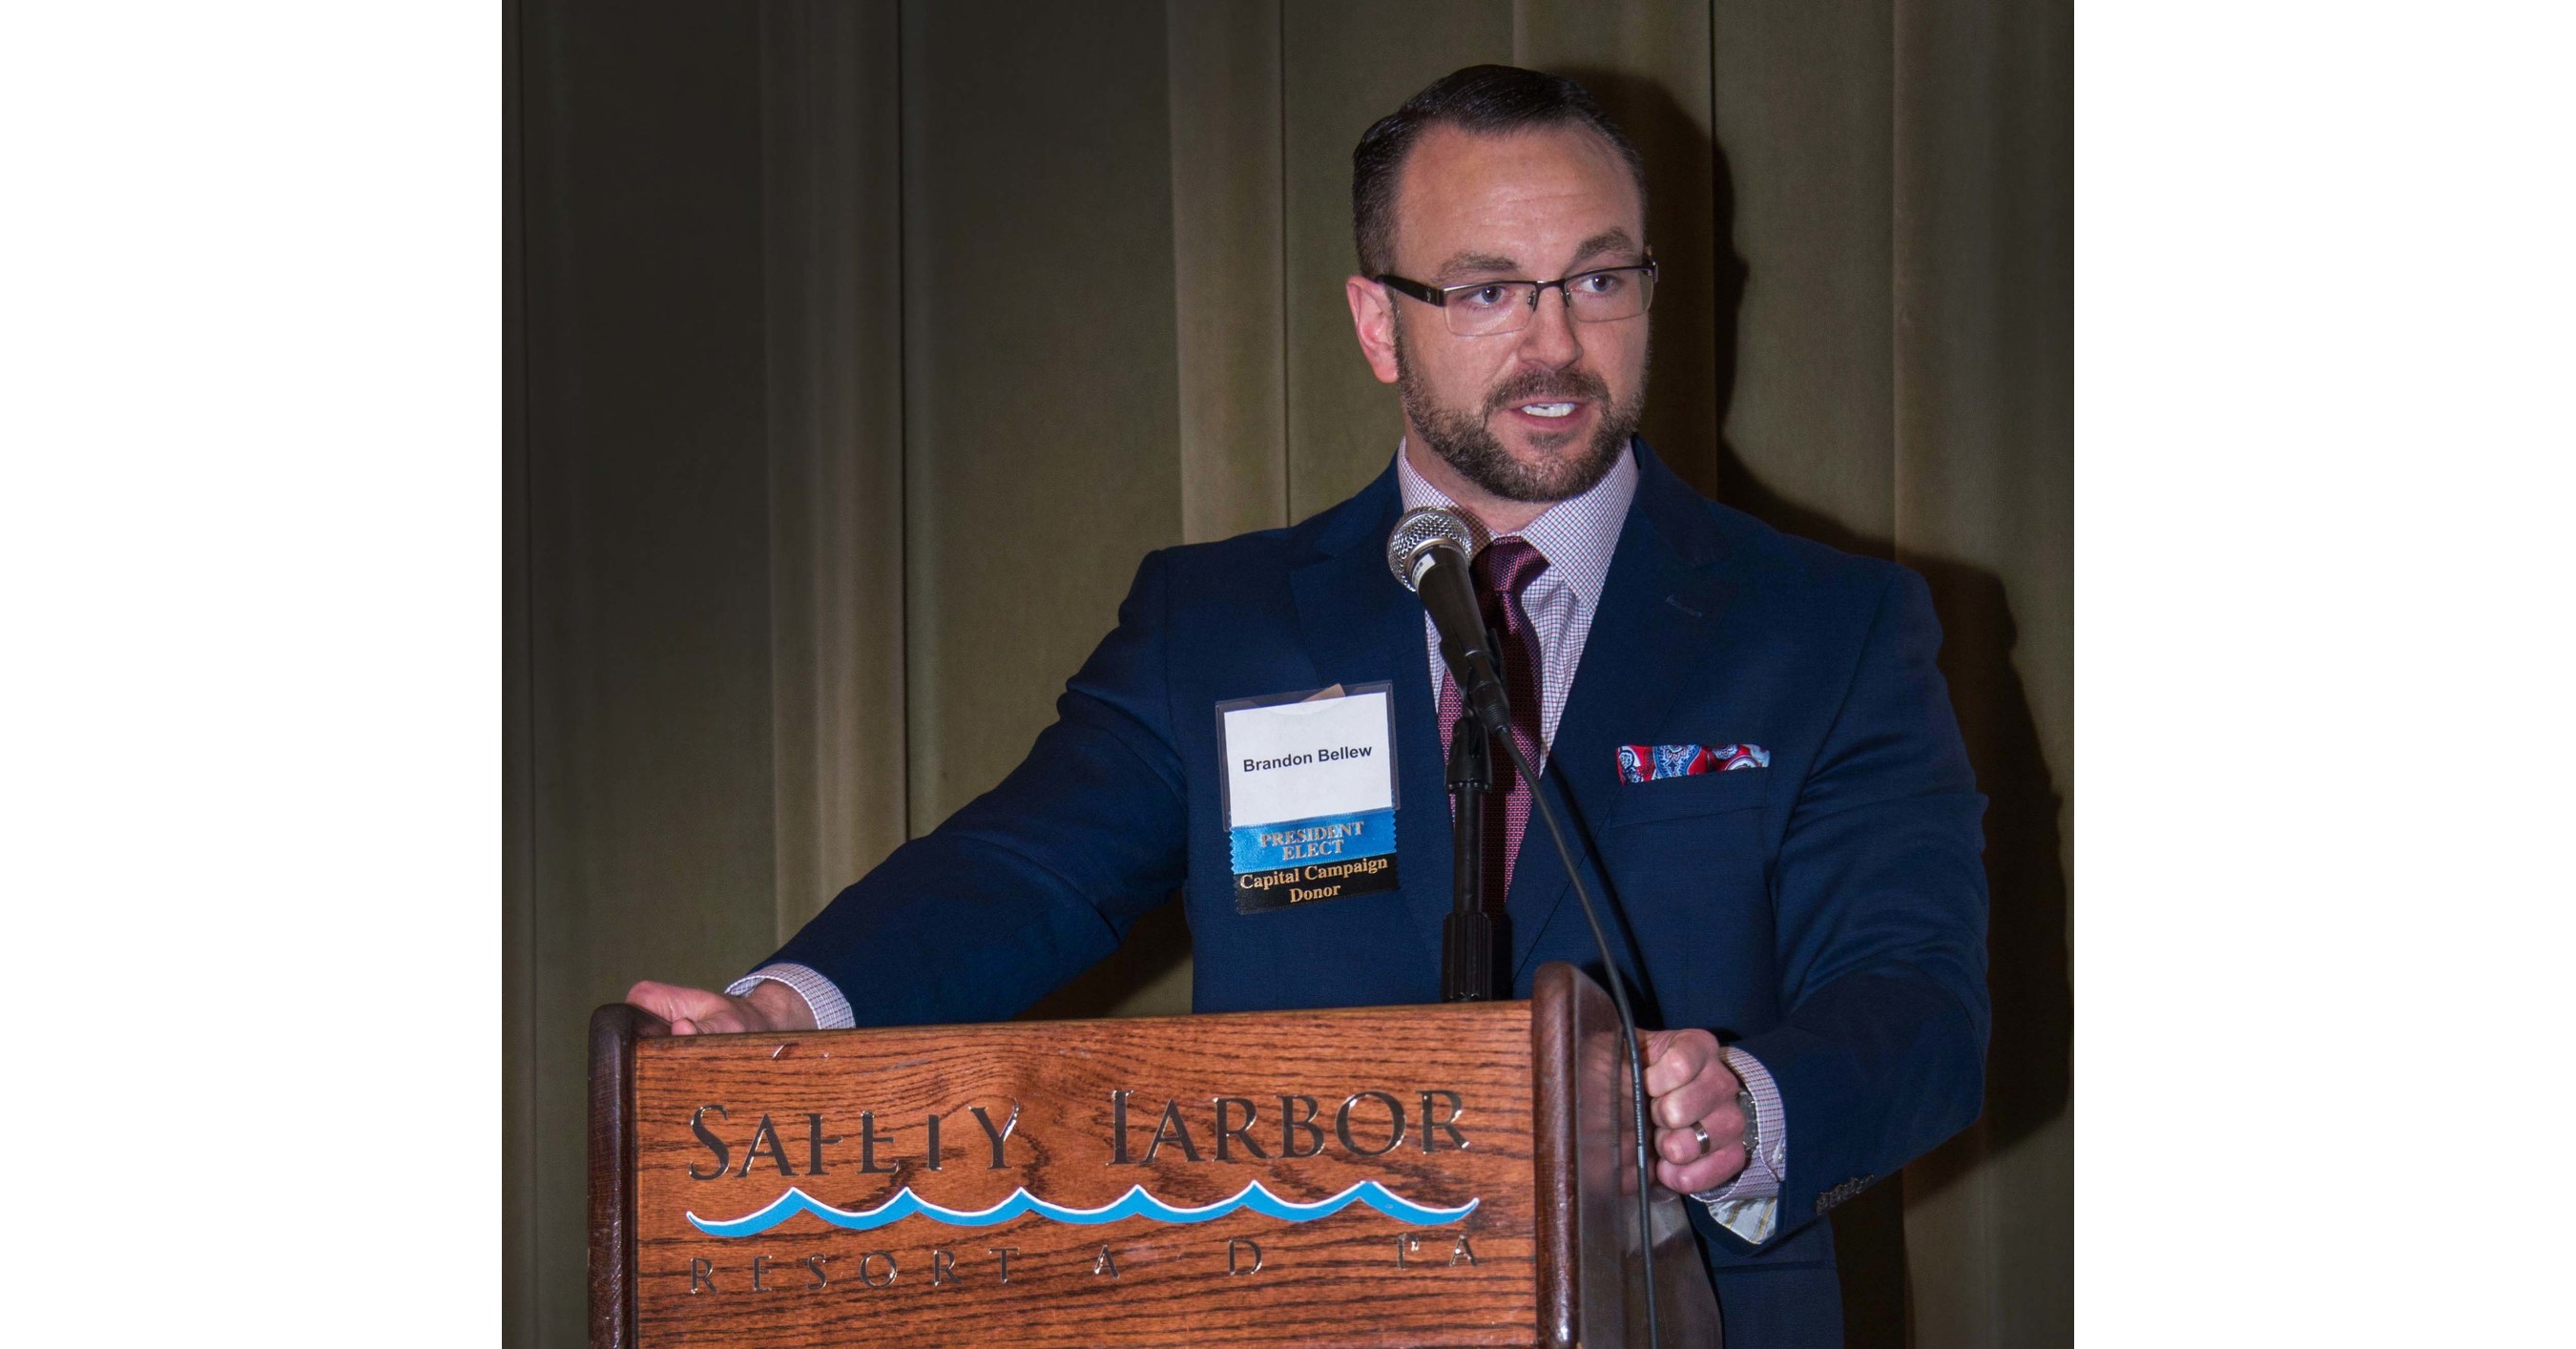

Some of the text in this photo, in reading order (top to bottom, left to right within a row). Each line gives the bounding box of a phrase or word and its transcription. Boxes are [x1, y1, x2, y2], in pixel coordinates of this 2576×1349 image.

[1243, 745, 1372, 772] Brandon Bellew
[1260, 821, 1364, 848] PRESIDENT
[1282, 840, 1344, 861] ELECT
[1239, 858, 1388, 891] Capital Campaign
[1290, 883, 1341, 903] Donor
[691, 1247, 1021, 1295] RESORT
[1093, 1239, 1263, 1279] AD
